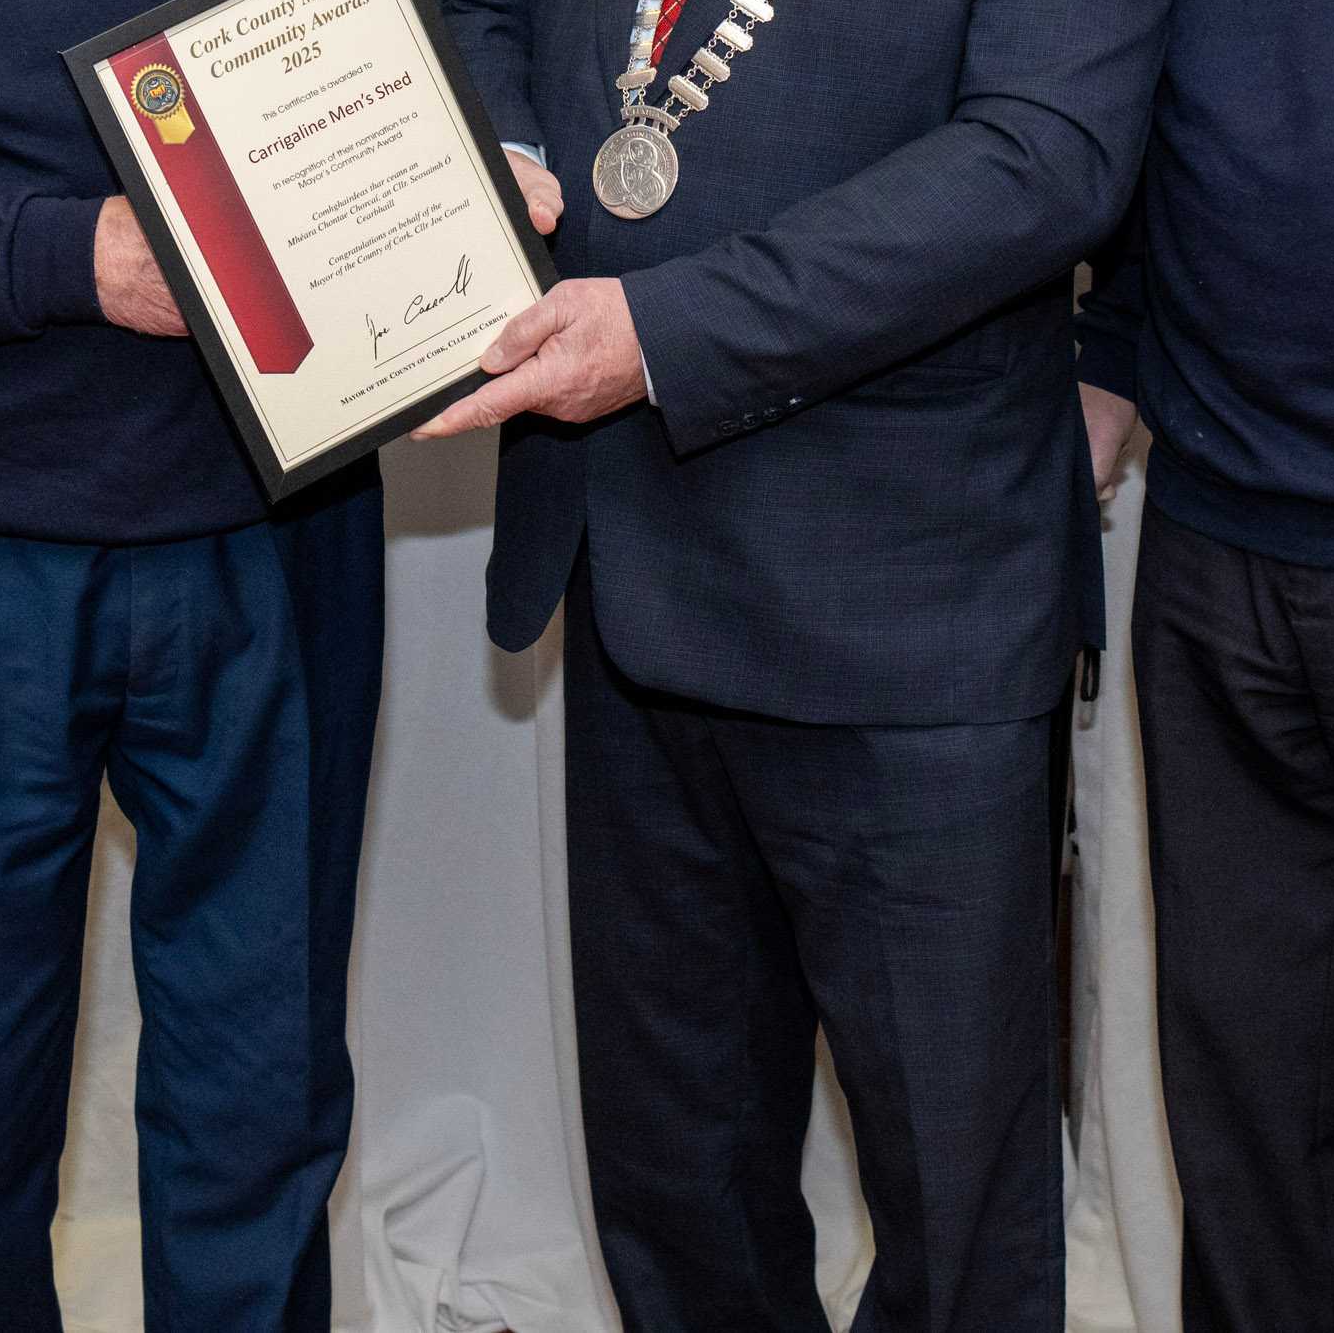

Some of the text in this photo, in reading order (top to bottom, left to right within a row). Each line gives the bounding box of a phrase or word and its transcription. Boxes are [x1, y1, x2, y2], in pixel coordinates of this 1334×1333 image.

[190, 27, 233, 59] Cork
[210, 22, 307, 78] Community
[282, 41, 322, 74] 2025
[262, 61, 373, 122] This Certificate is awarded to
[248, 71, 412, 164] Carrigaline Men's Shed
[272, 111, 418, 191] In recognition of their nomination for a
[330, 145, 376, 172] Community
[376, 130, 403, 150] Award
[409, 161, 419, 171] an
[381, 189, 392, 199] an
[309, 270, 334, 290] Mayor
[334, 264, 344, 276] of
[344, 260, 355, 272] the
[356, 245, 383, 266] County
[383, 240, 394, 252] of
[430, 214, 443, 227] Joe
[444, 198, 471, 219] Carroll
[328, 201, 443, 267] Congratulations on behalf of the
[389, 361, 417, 380] COUNTY
